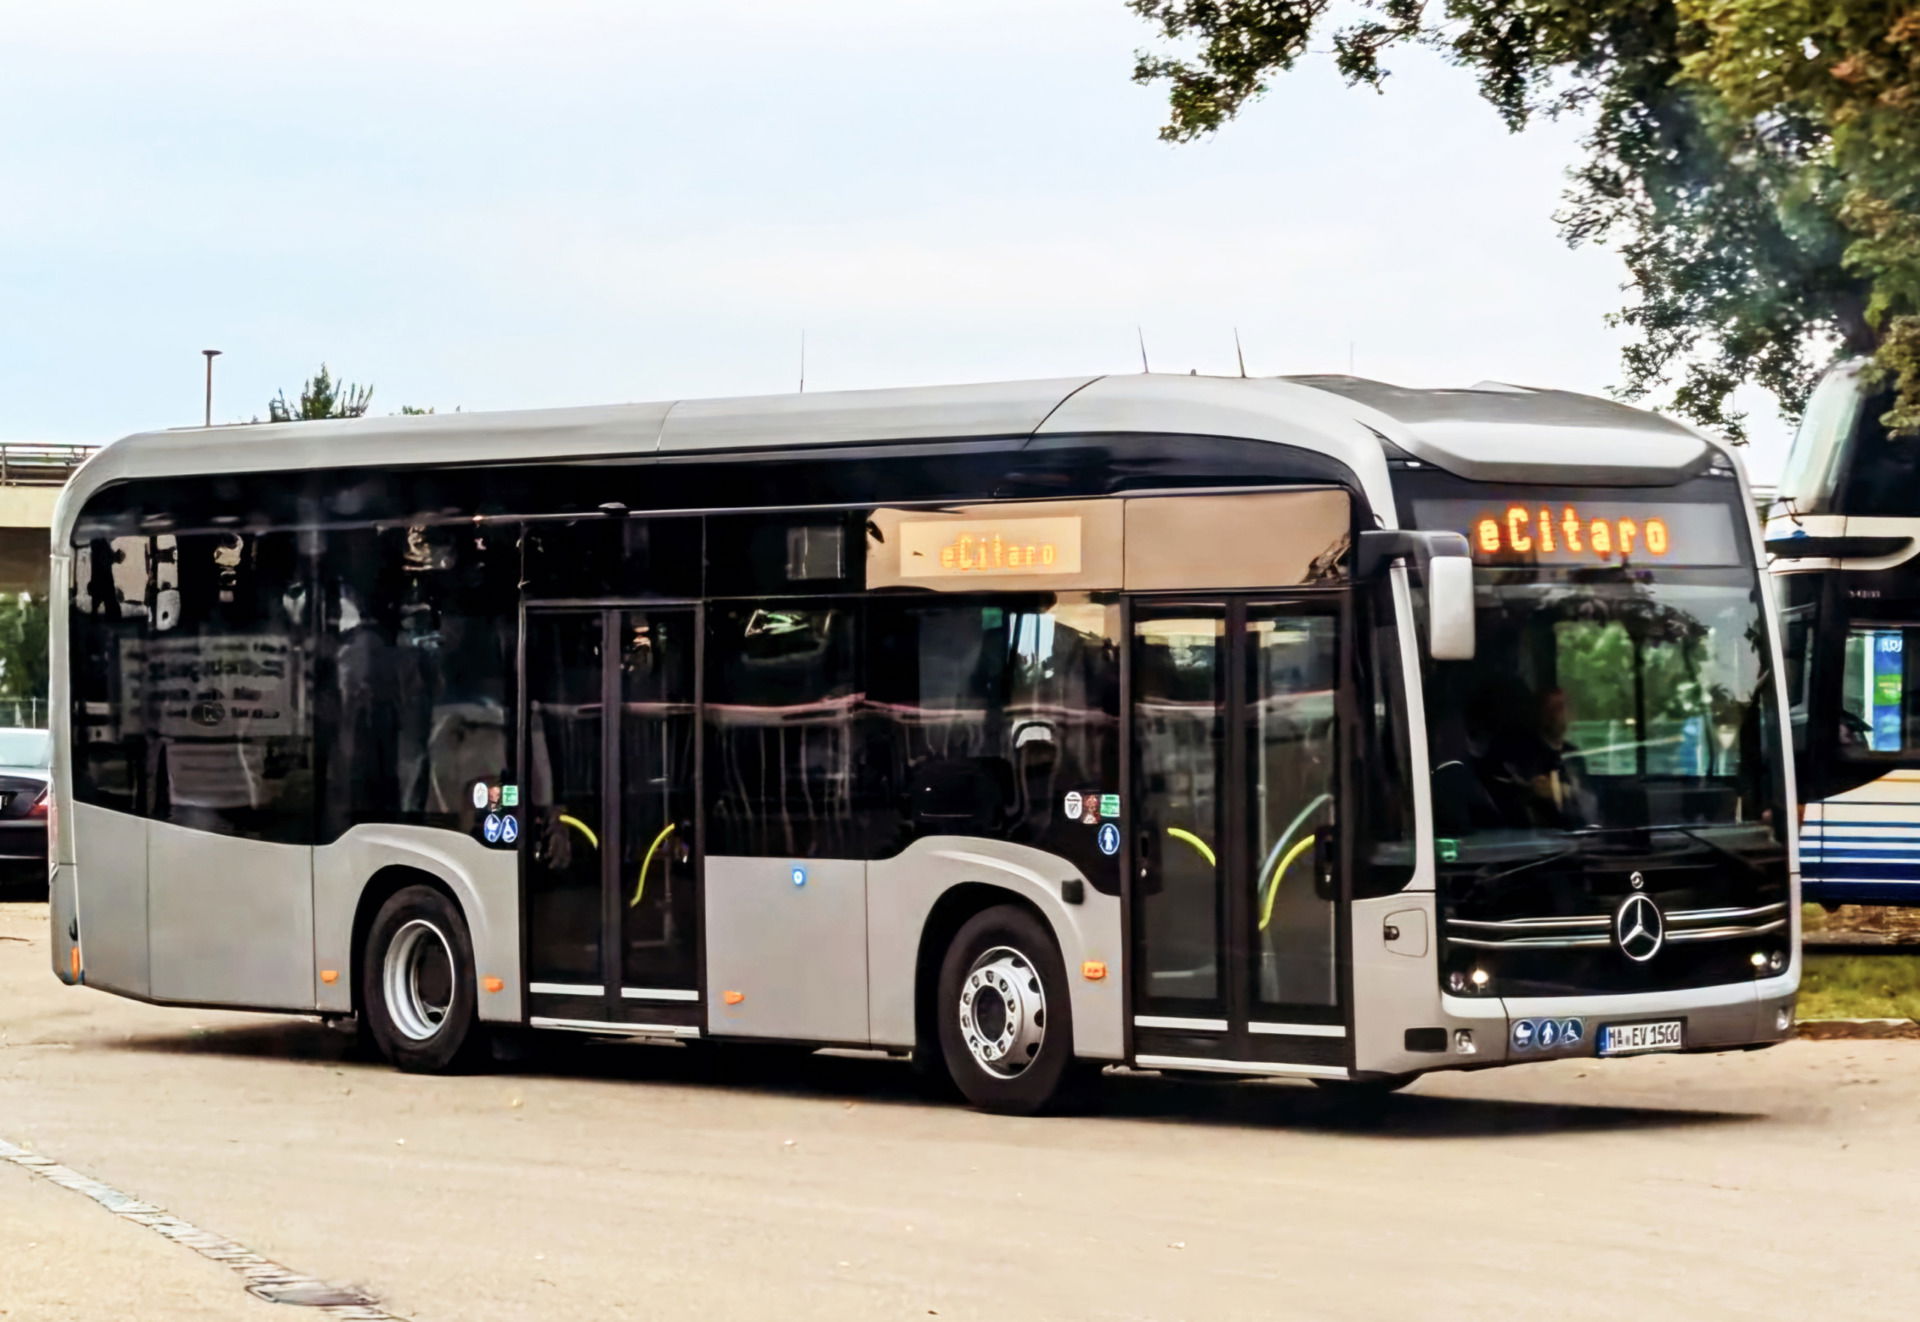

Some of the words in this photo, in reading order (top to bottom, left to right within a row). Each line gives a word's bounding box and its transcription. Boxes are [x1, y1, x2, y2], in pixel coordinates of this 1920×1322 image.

[1477, 505, 1669, 554] eCitaro
[941, 534, 1056, 570] eCitaro
[1632, 1027, 1647, 1046] EV
